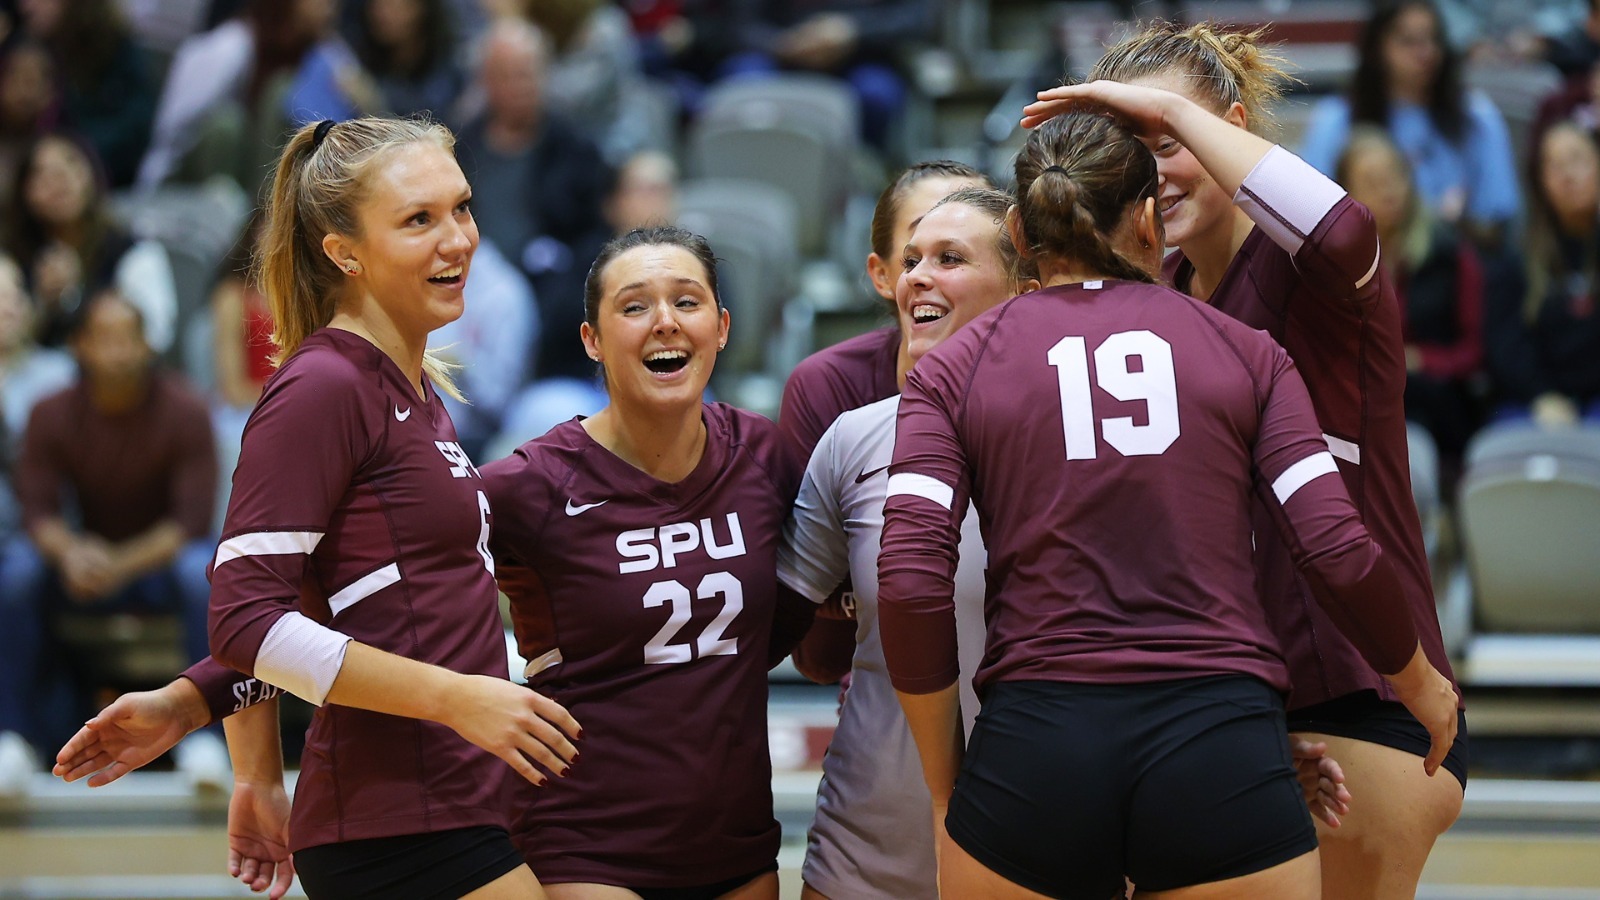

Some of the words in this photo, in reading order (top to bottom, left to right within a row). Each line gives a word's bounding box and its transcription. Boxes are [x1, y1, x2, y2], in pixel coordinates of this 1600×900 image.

[1047, 329, 1181, 461] 19
[476, 489, 497, 580] 6
[615, 511, 747, 575] SPU
[642, 571, 744, 665] 22
[232, 678, 288, 712] SEA
